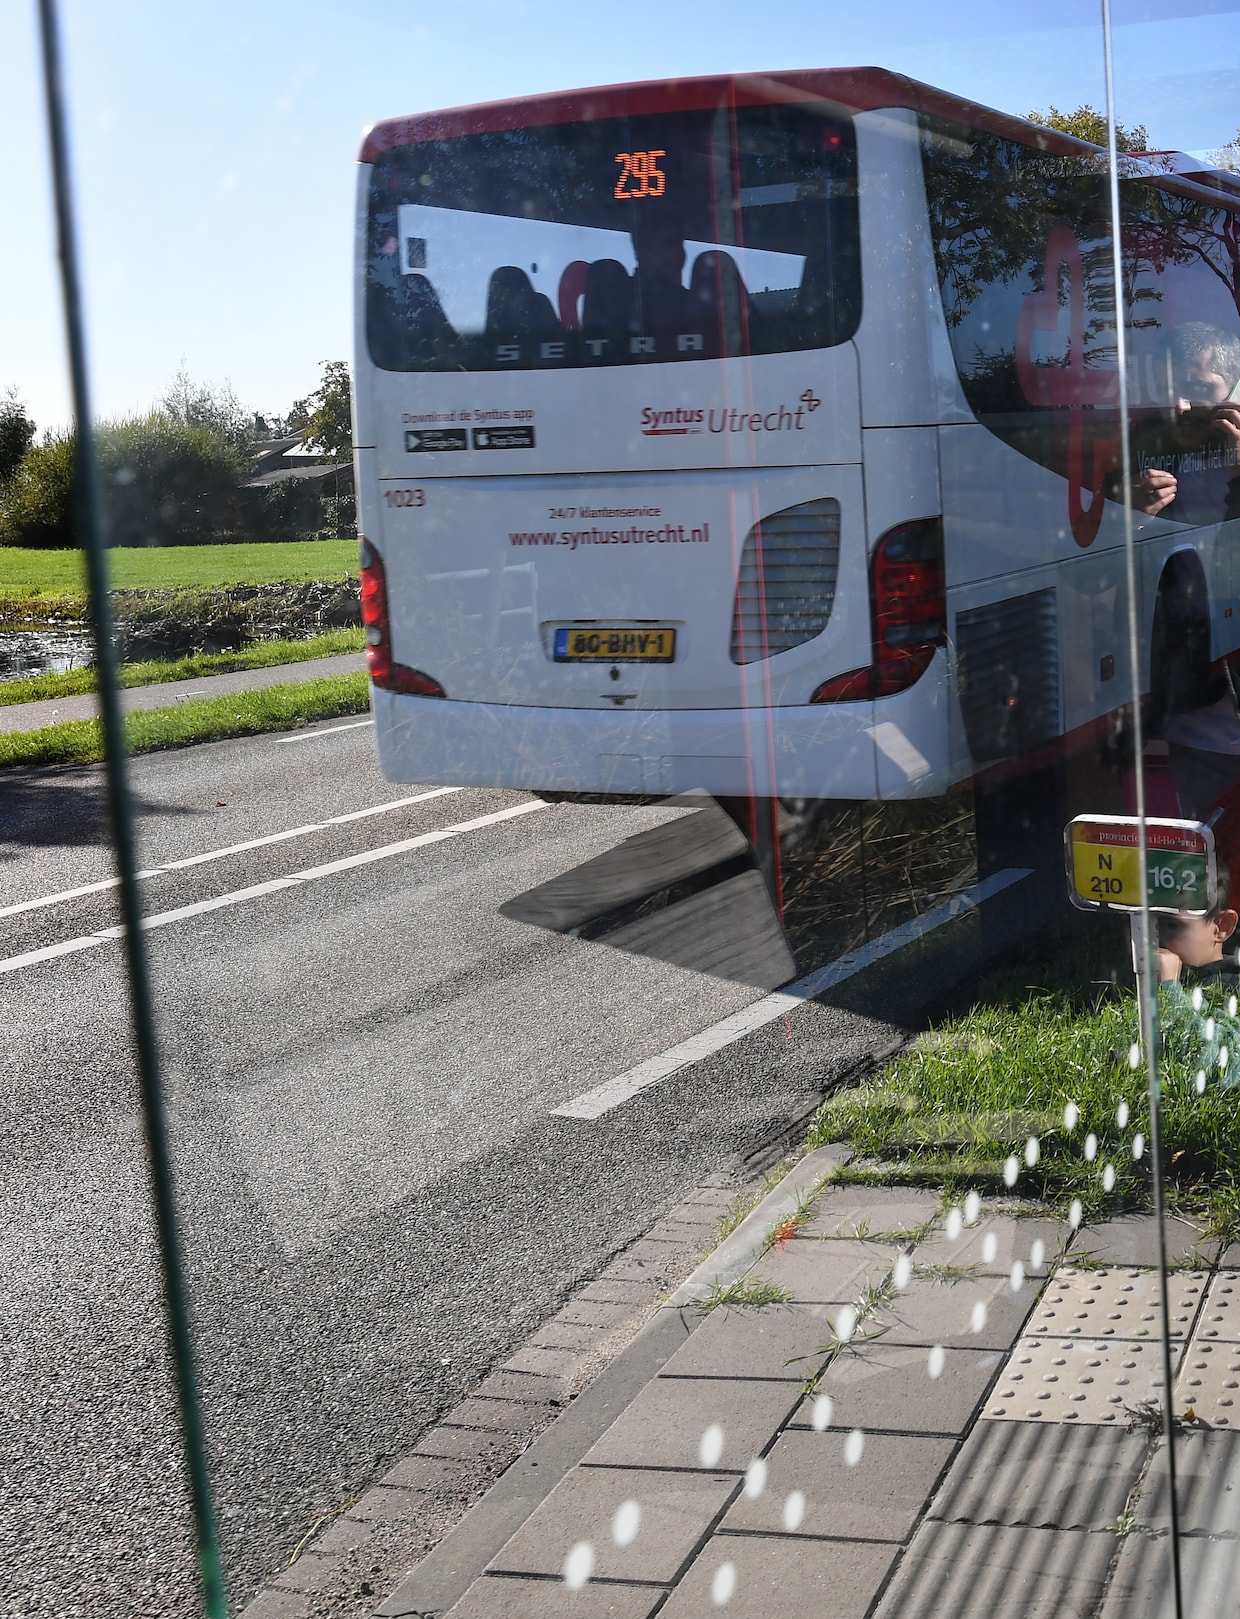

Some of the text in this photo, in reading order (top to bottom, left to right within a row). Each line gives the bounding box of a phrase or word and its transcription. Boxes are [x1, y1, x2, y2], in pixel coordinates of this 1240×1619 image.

[613, 150, 667, 199] 295
[495, 333, 705, 363] SETRA
[402, 409, 535, 424] Download de Syntus app
[640, 404, 806, 434] Syntus Utrecht
[384, 488, 427, 508] 1023
[549, 505, 662, 519] 24/7 klantenservice
[508, 523, 710, 550] www.syntusutrecht.nl
[573, 633, 665, 654] 80-BHV-1
[1098, 853, 1112, 871] N
[1090, 876, 1123, 895] 210
[1148, 864, 1198, 895] 16,2
